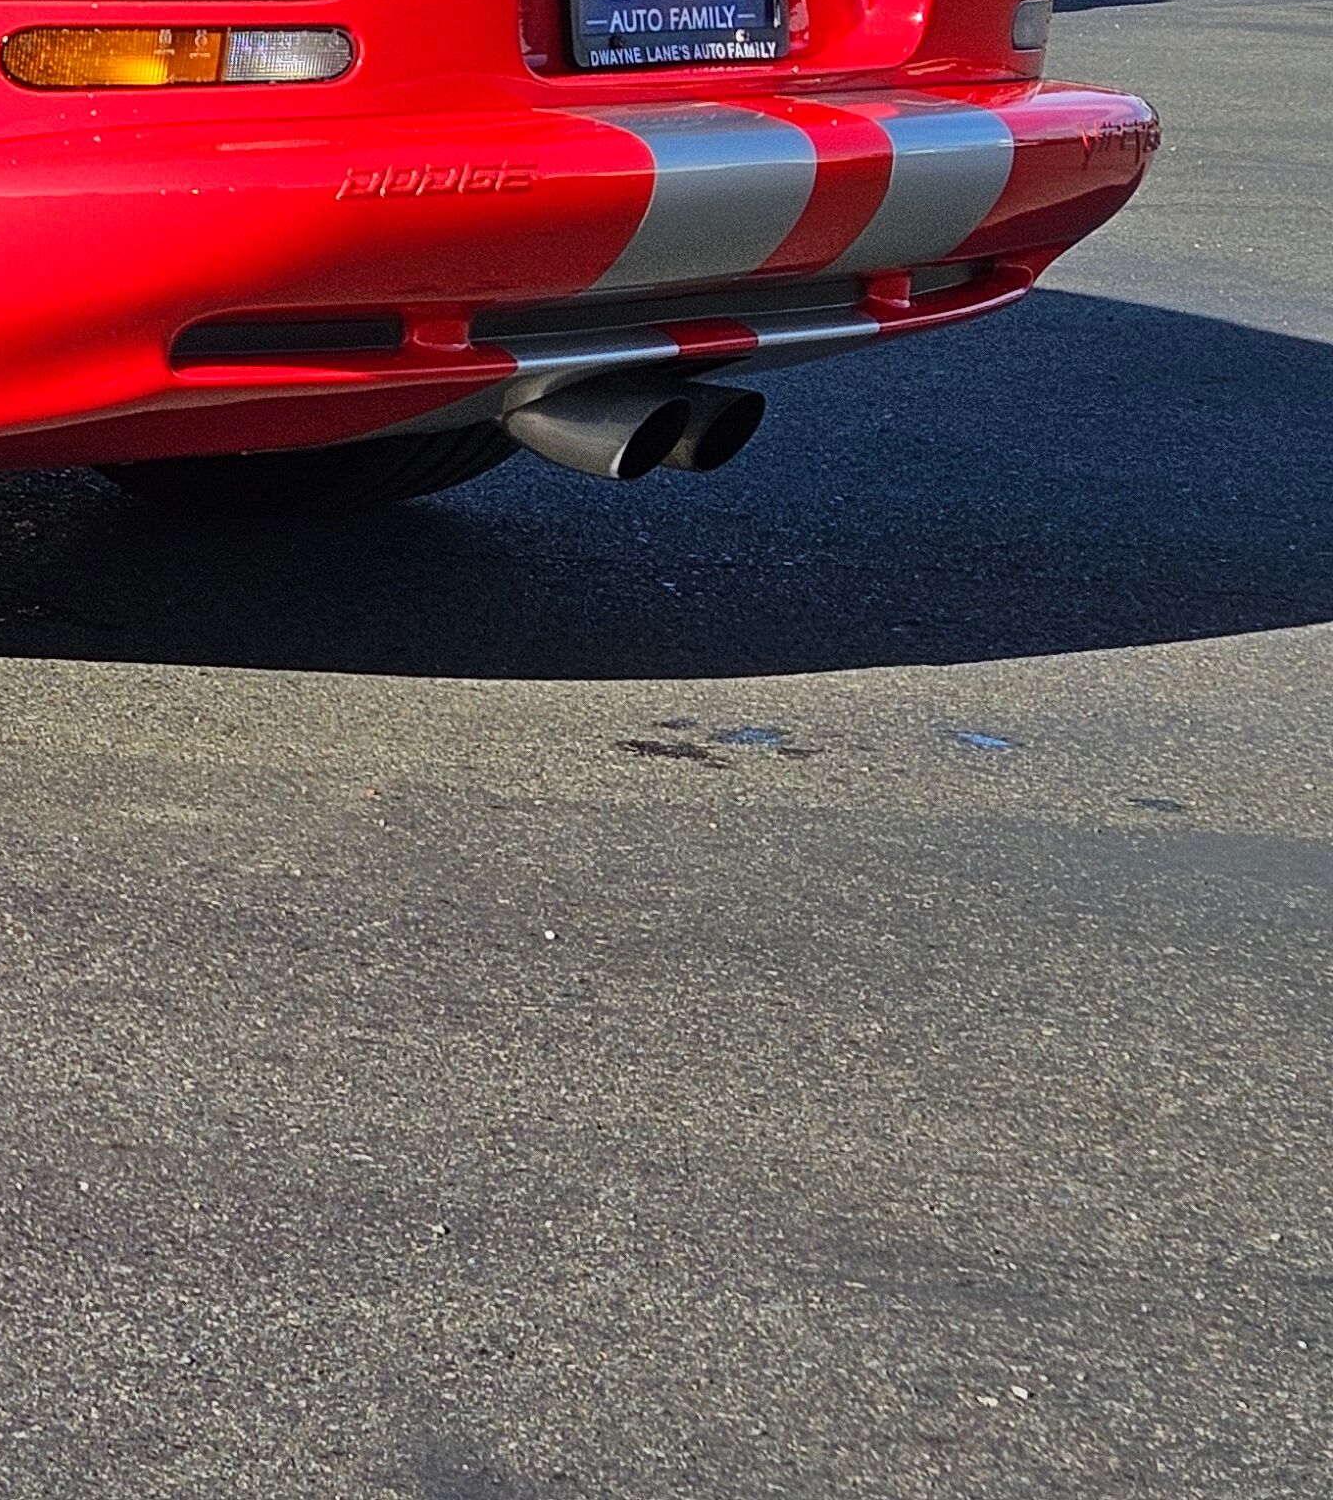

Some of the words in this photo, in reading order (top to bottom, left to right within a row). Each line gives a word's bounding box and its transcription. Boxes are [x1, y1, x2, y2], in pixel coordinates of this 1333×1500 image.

[609, 8, 663, 34] AUTO
[669, 4, 736, 30] FAMILY
[590, 46, 643, 67] DWAYNE
[646, 44, 690, 63] LANE'S
[693, 42, 726, 60] AUTO
[726, 41, 777, 59] FAMILY
[335, 159, 539, 201] DODGE
